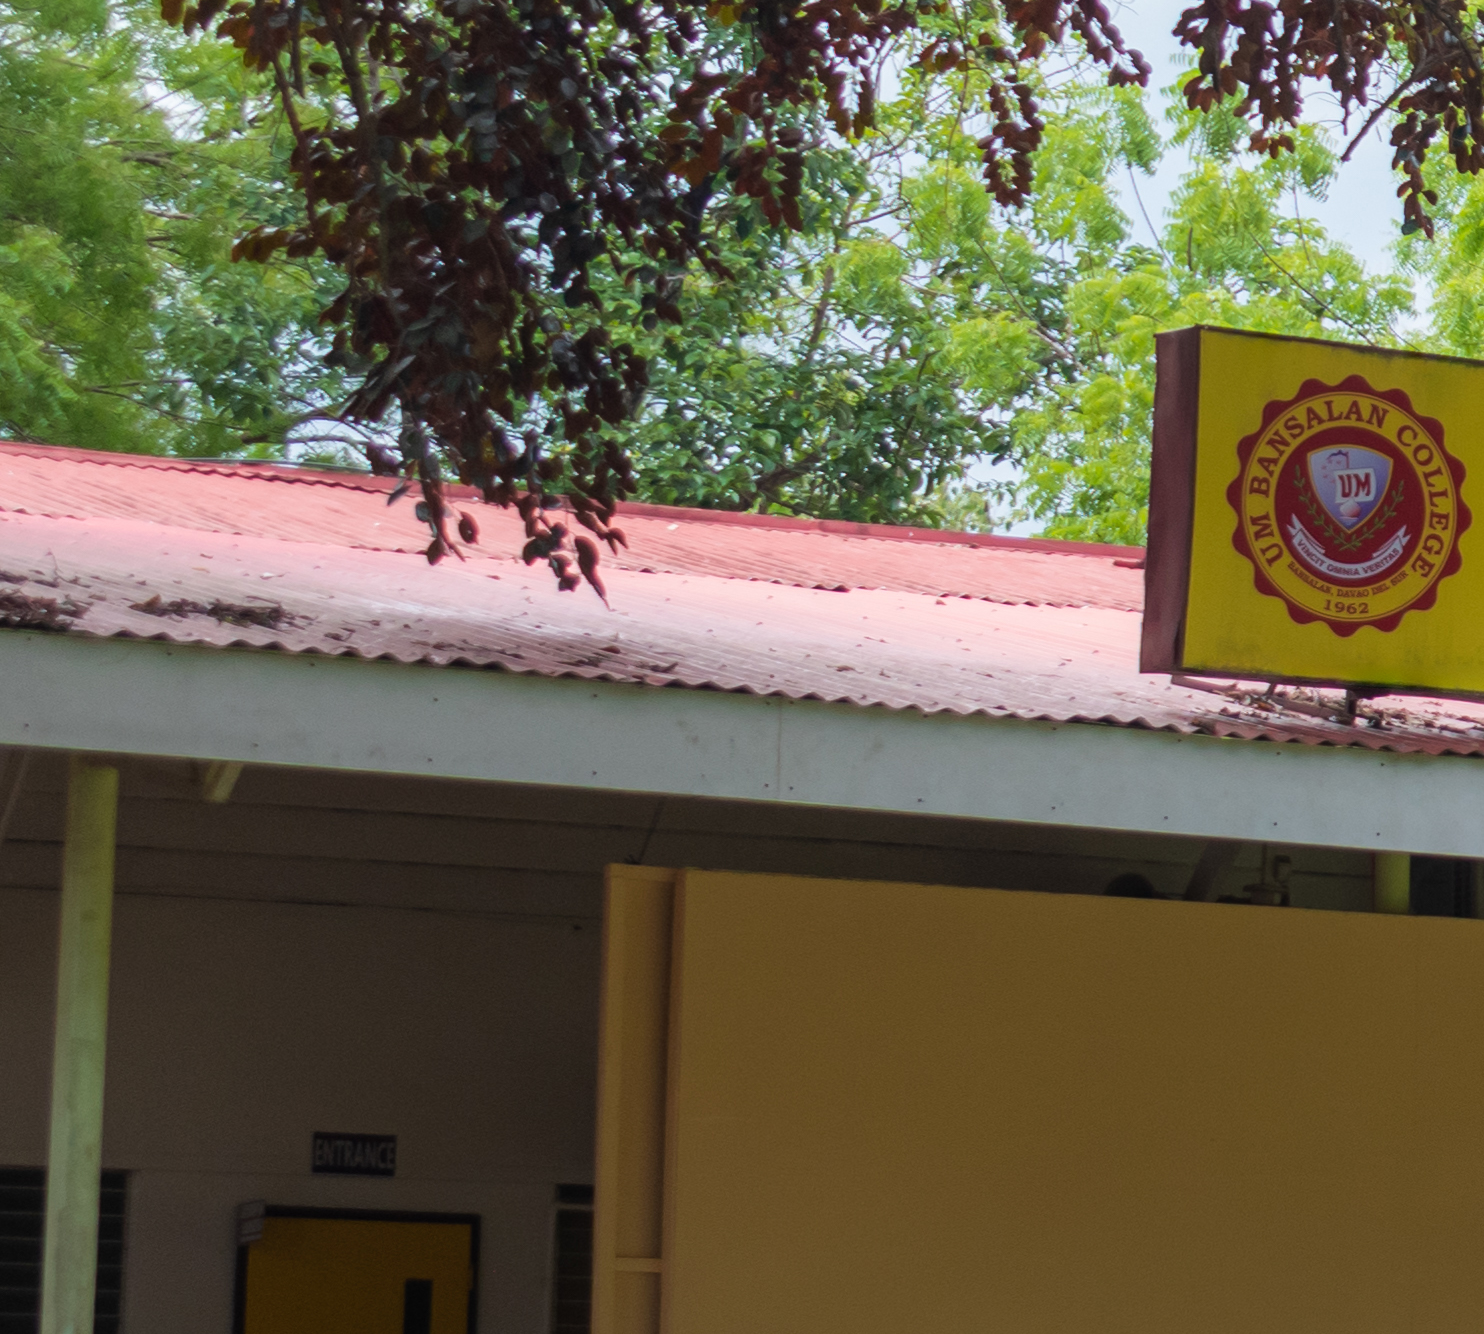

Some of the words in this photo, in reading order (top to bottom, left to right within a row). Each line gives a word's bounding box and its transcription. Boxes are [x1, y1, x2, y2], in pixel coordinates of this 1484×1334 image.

[1249, 400, 1390, 498] BANSALAN
[1337, 472, 1371, 499] UM
[1396, 425, 1449, 578] COLLEGE
[1250, 512, 1284, 566] UM
[1324, 600, 1369, 614] 1962
[315, 1138, 395, 1169] ENTRANCE
